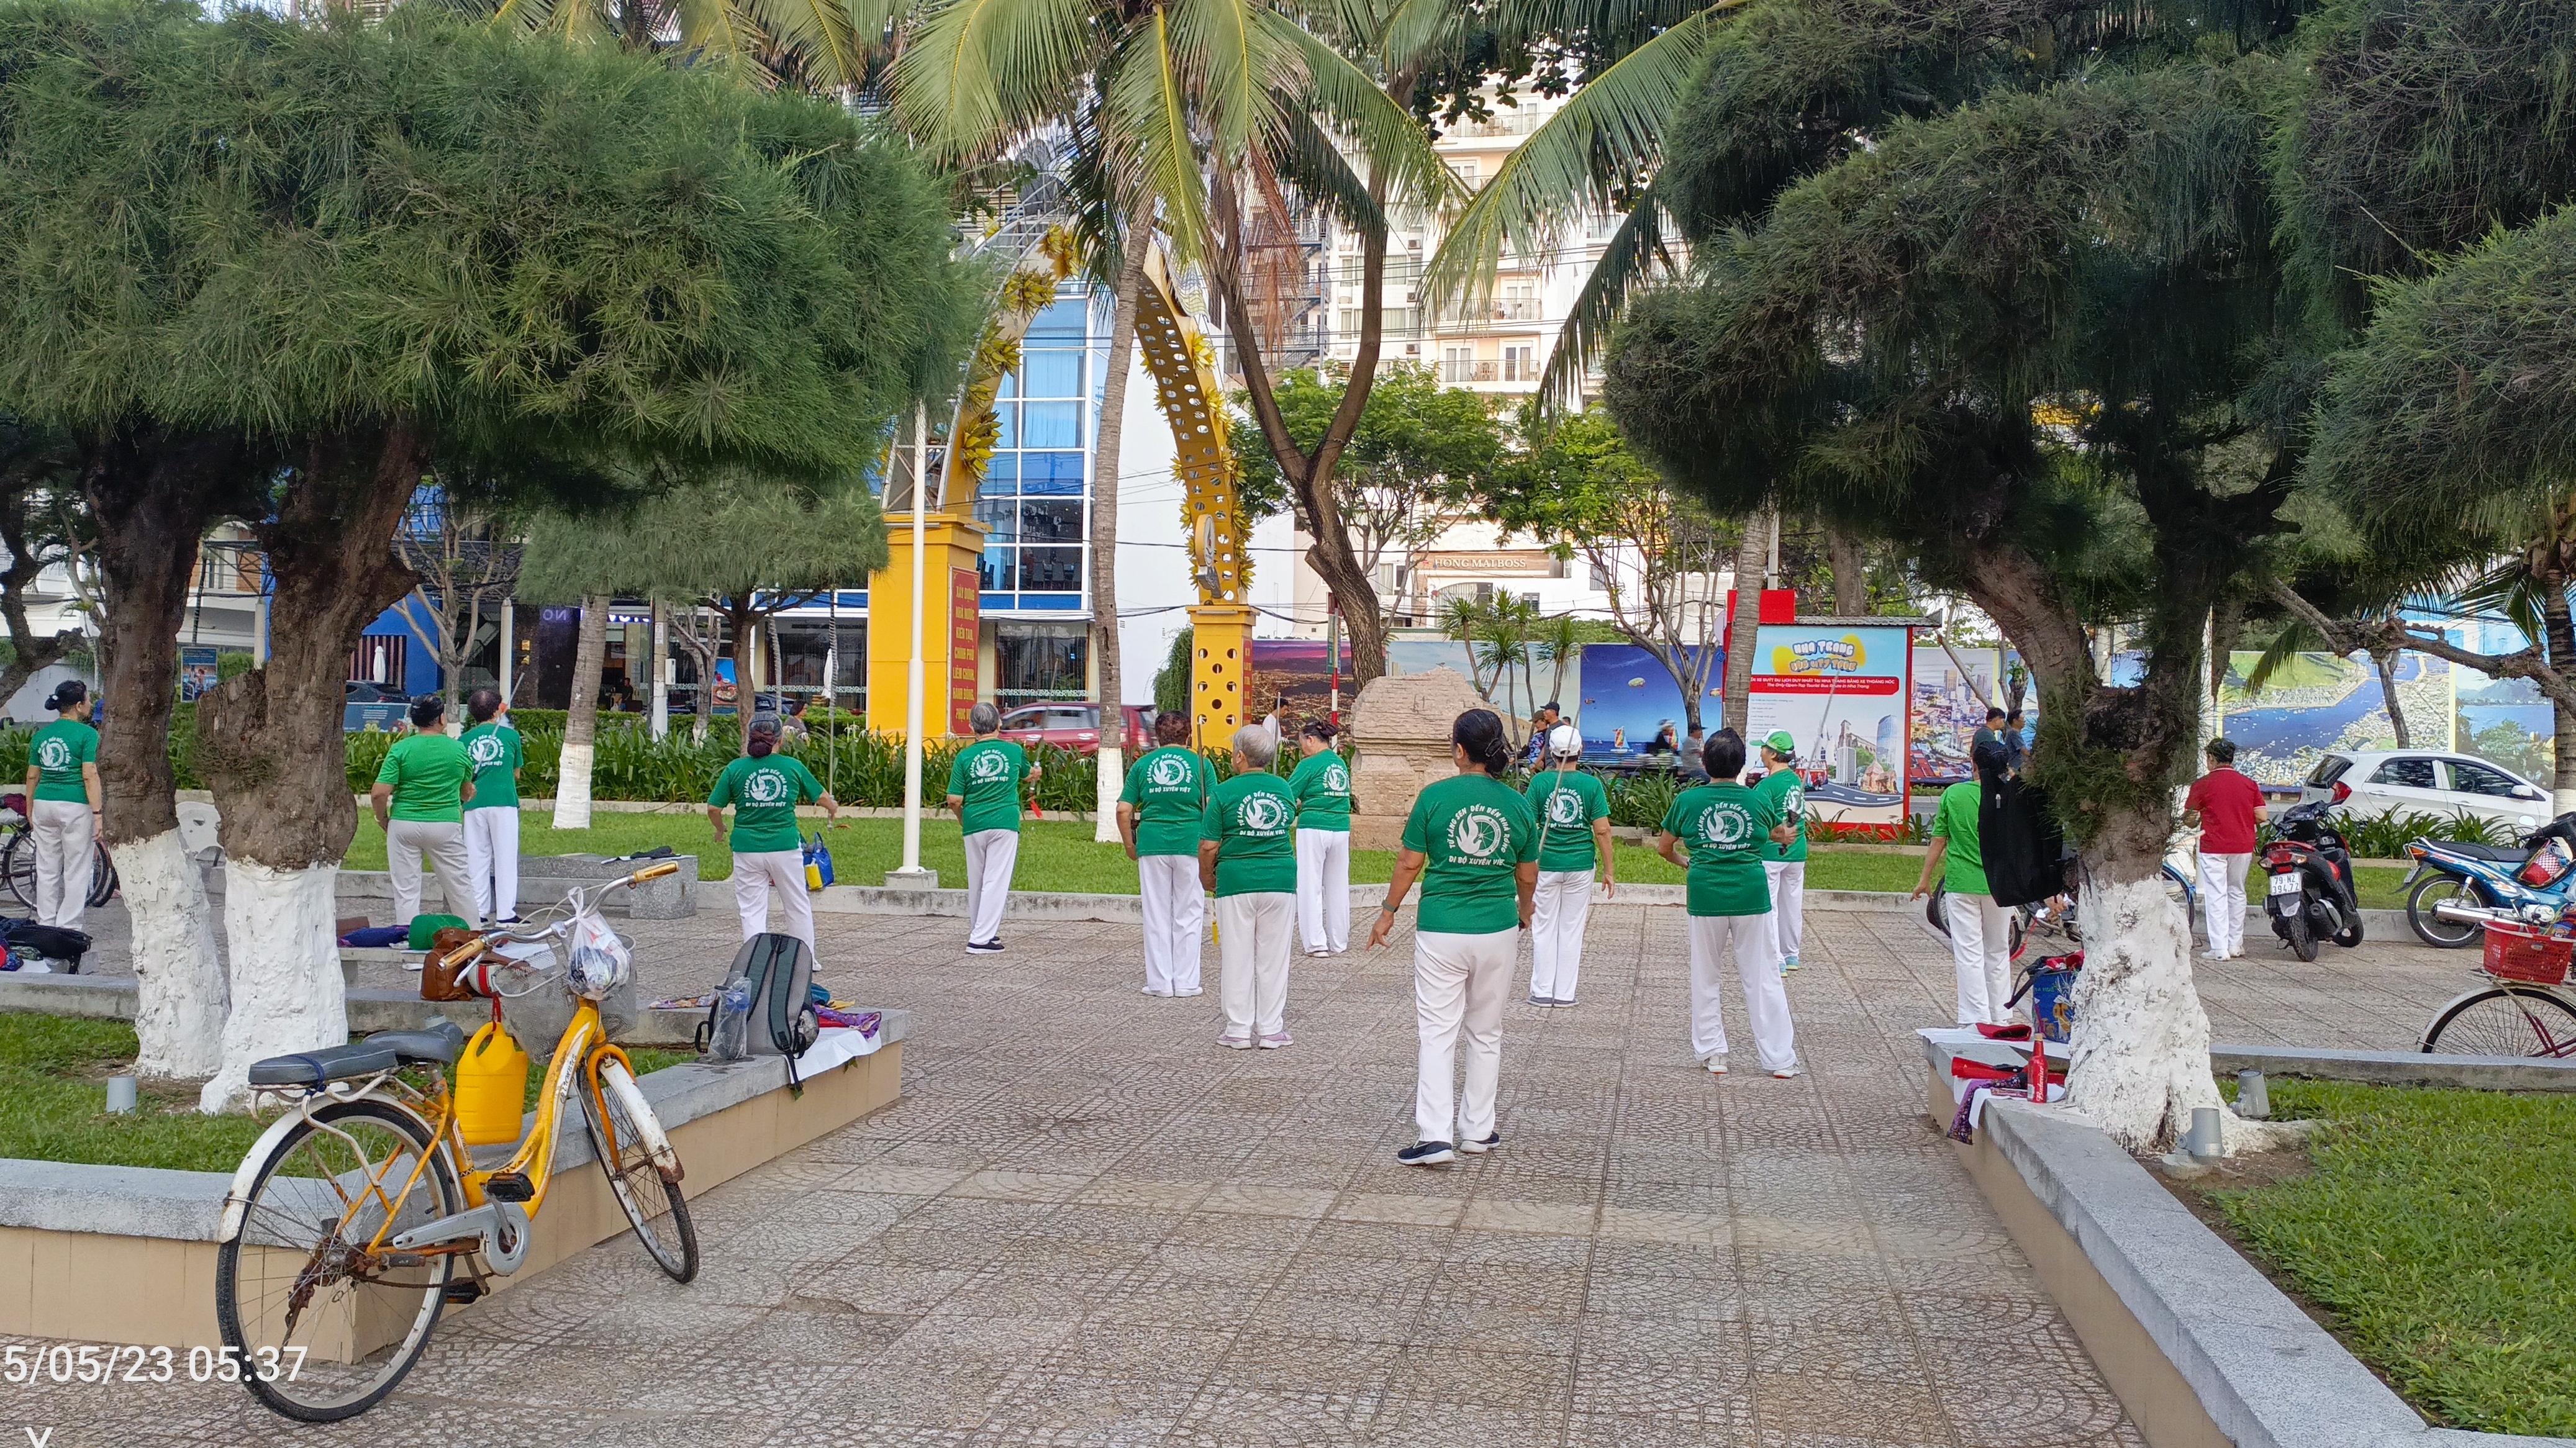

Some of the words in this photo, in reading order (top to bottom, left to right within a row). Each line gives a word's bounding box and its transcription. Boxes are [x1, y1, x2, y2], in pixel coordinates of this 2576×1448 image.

[1472, 559, 1494, 568] MAI
[1497, 559, 1526, 568] BOSS
[1817, 640, 1854, 656] TRANG
[1455, 807, 1467, 820] SEN
[1470, 803, 1485, 812] ĐẾN
[1486, 807, 1502, 818] BẾN
[1446, 818, 1457, 838] LÀNG
[1499, 817, 1511, 831] NHÀ
[1500, 833, 1511, 853] RỒNG
[1469, 857, 1491, 866] XUYÊN
[2273, 882, 2299, 894] 394.72
[2036, 1064, 2044, 1102] Budweiser
